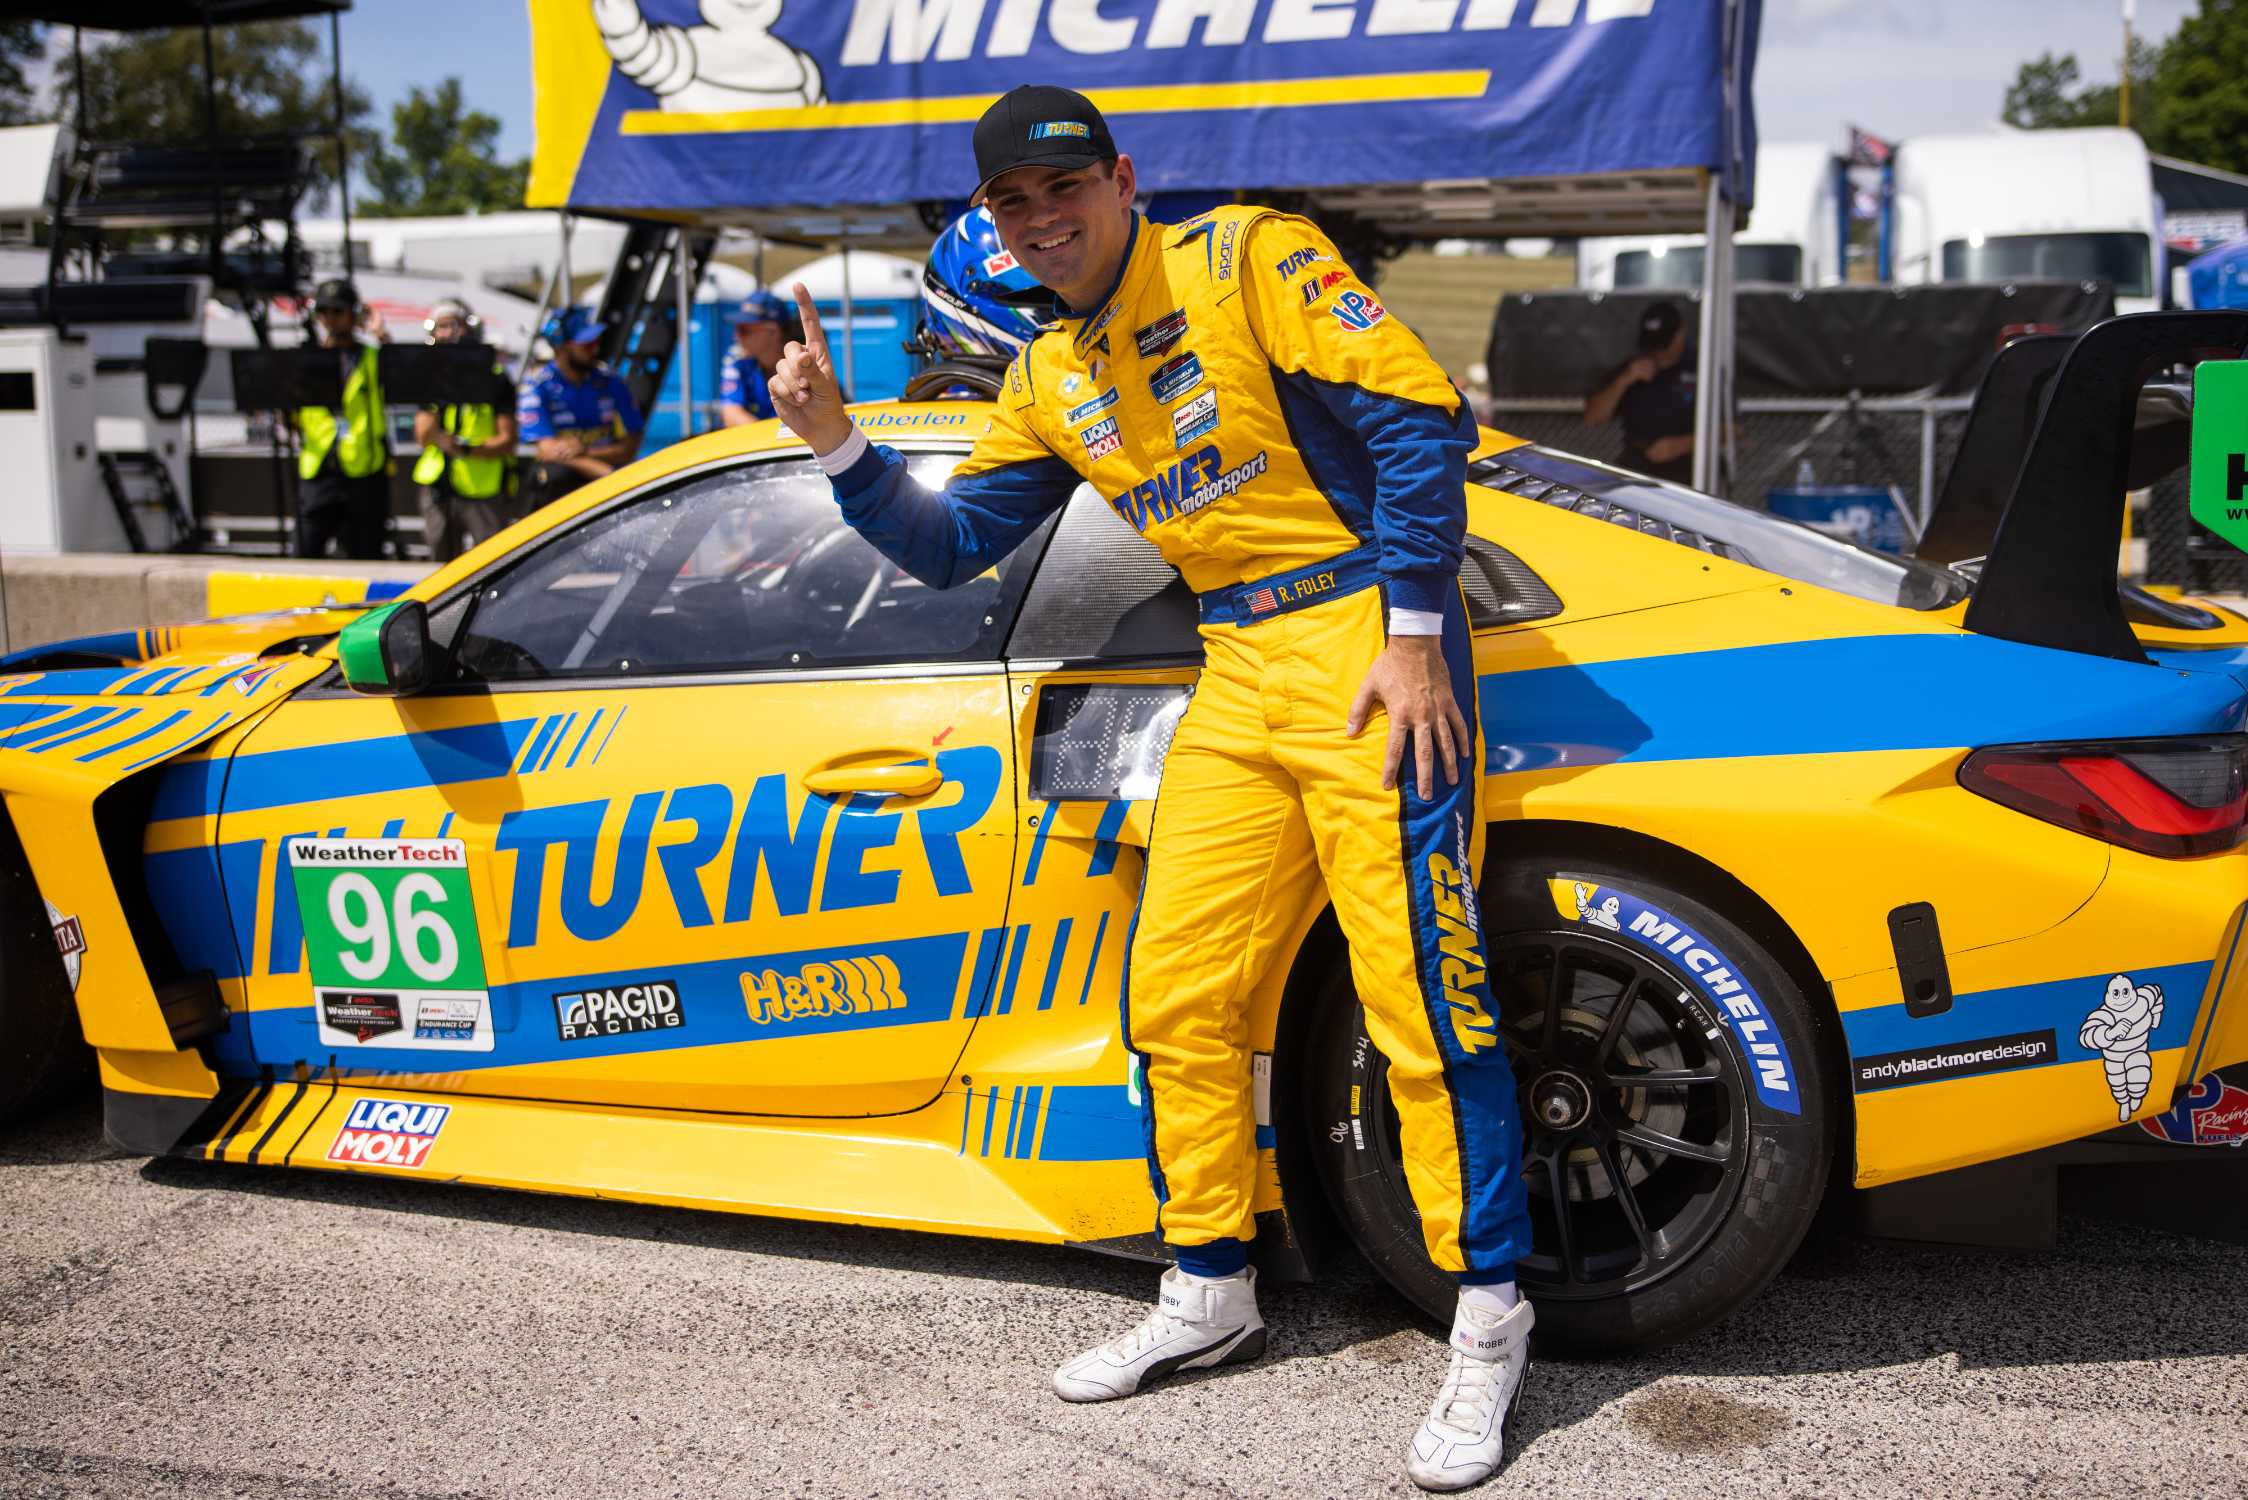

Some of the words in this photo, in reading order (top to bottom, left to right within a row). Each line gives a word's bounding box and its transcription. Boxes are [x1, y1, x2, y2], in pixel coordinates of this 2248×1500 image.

[1218, 220, 1240, 280] sparco
[1080, 391, 1116, 417] MICHELIN
[1081, 419, 1118, 447] LIQUI
[1087, 432, 1121, 461] MOLY
[1111, 444, 1224, 533] TURNER
[1179, 450, 1268, 516] motorsport
[1277, 586, 1295, 604] R.
[1294, 571, 1337, 599] FOLEY
[295, 844, 459, 861] WeatherTech
[495, 745, 1003, 950] TURNER
[326, 871, 459, 982] 96
[1427, 852, 1498, 1055] TURNER
[586, 984, 676, 1022] PAGID
[740, 962, 853, 1025] H&R
[1629, 910, 1790, 1092] MICHELIN
[562, 1012, 681, 1039] RACING
[1862, 1041, 2047, 1080] andyblackmoredesign
[348, 1100, 446, 1135] LIQUI
[331, 1130, 435, 1165] MOLY
[1478, 1336, 1508, 1349] ROBBY
